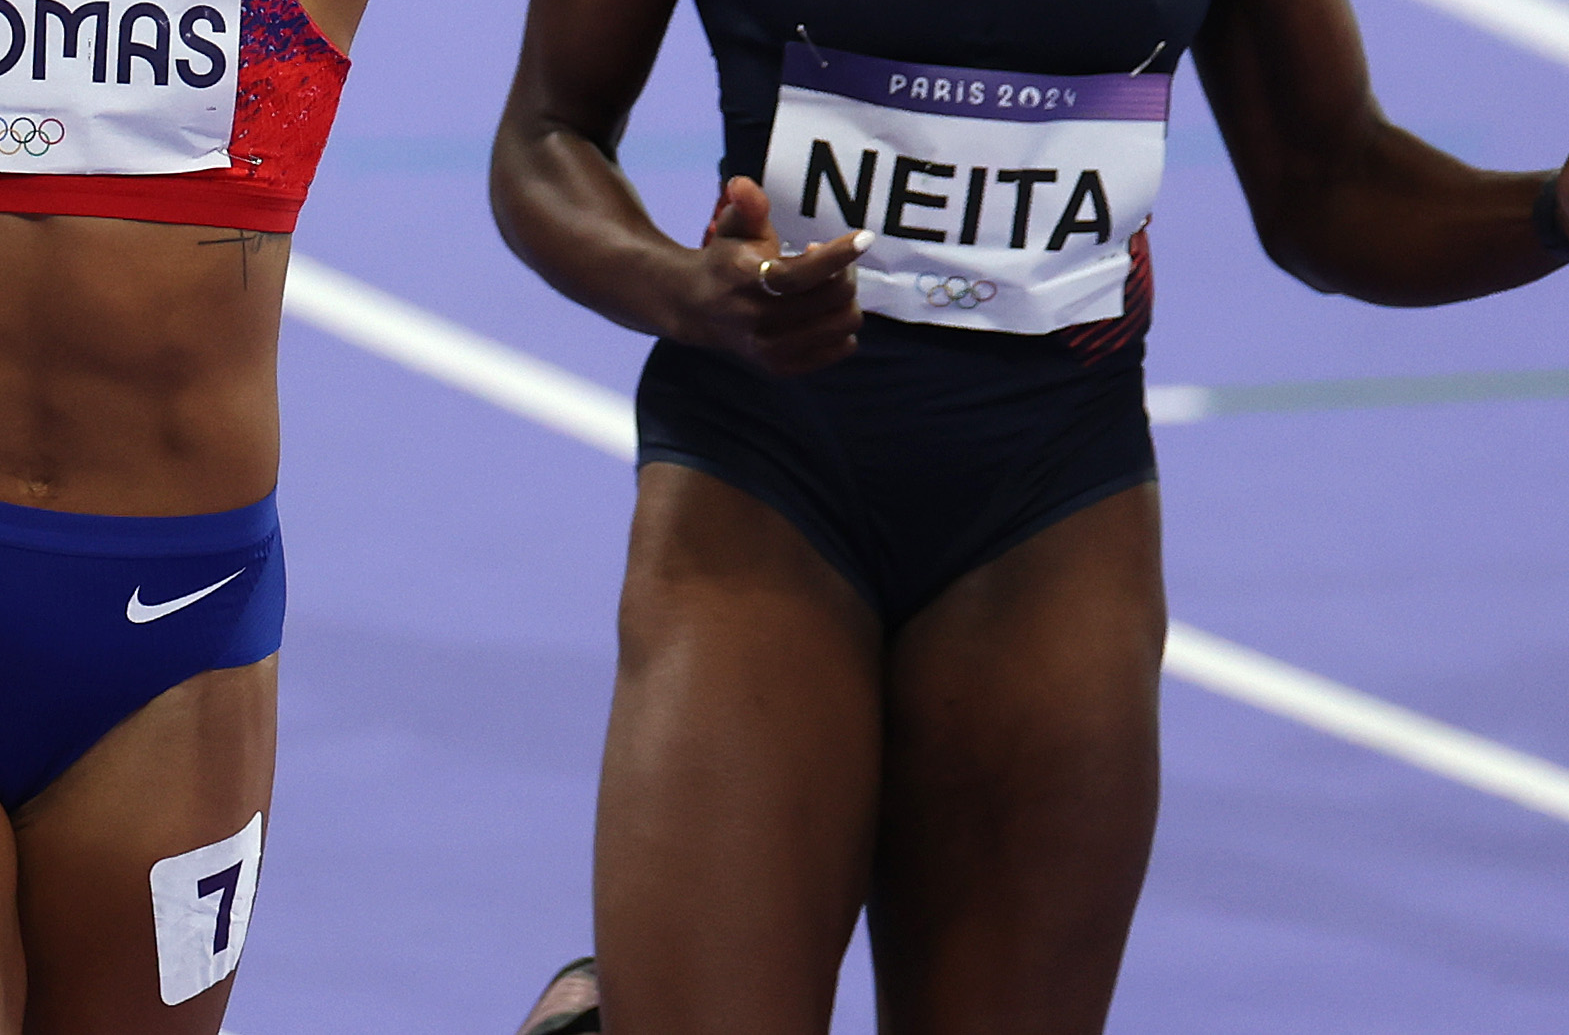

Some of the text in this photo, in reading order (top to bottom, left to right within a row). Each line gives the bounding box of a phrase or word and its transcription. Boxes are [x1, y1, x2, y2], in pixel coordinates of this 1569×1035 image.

[996, 84, 1077, 110] 2024
[799, 139, 1112, 252] NEITA
[197, 858, 244, 957] 7
